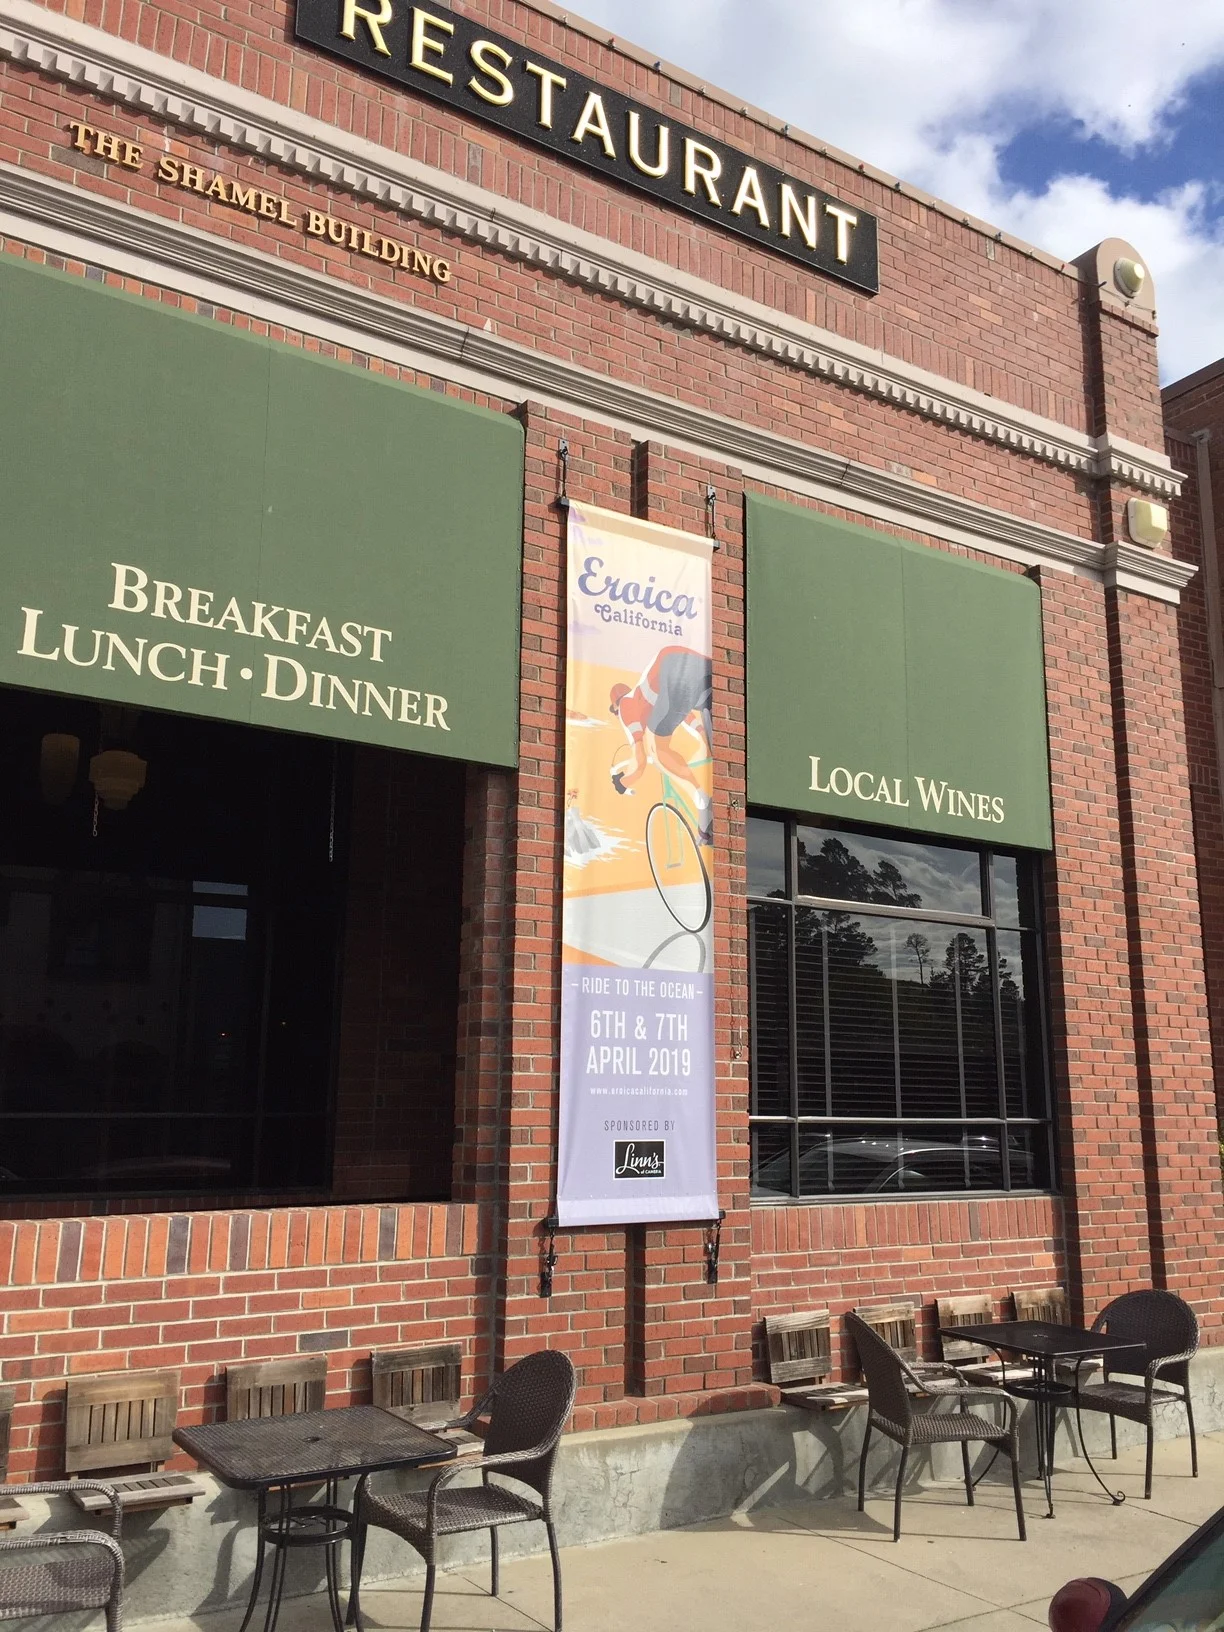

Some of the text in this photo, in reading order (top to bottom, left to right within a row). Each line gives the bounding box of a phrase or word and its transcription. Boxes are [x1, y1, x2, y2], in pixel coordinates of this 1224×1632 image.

[339, 0, 859, 265] RESTAURANT
[70, 121, 453, 284] THE SHAMEL BUILDING
[577, 556, 698, 620] Eroica
[594, 603, 683, 637] California
[582, 977, 695, 1000] RIDE TO THE OCEAN
[590, 1009, 688, 1041] 6TH & 7TH
[586, 1045, 691, 1077] APRIL 2019
[590, 1086, 688, 1097] www.eroicacalifornia.com
[604, 1120, 675, 1131] SPONSORED BY
[616, 1143, 660, 1174] Linn's
